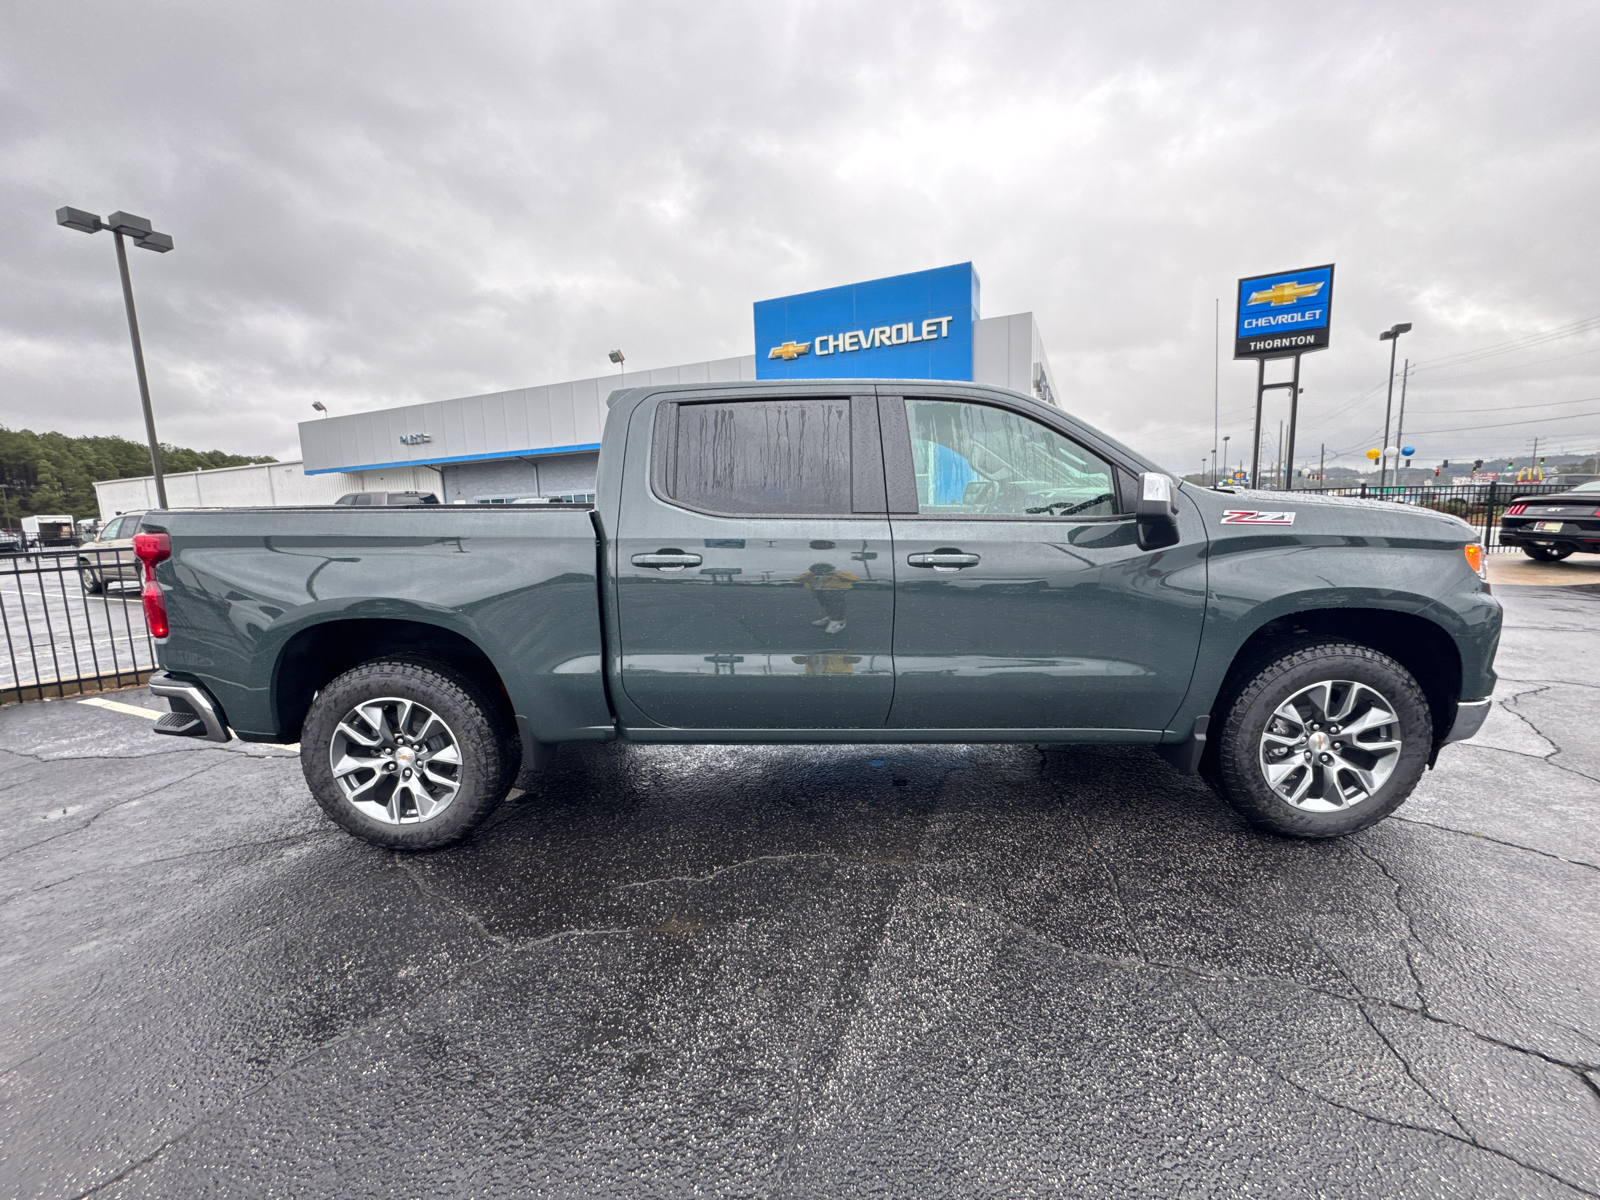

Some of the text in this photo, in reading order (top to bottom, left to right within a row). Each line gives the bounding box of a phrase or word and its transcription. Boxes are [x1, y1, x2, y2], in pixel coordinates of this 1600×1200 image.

[1244, 309, 1322, 328] CHEVROLET
[814, 316, 953, 356] CHEVROLET
[1249, 335, 1315, 351] THORNTON
[1220, 510, 1296, 526] Z71
